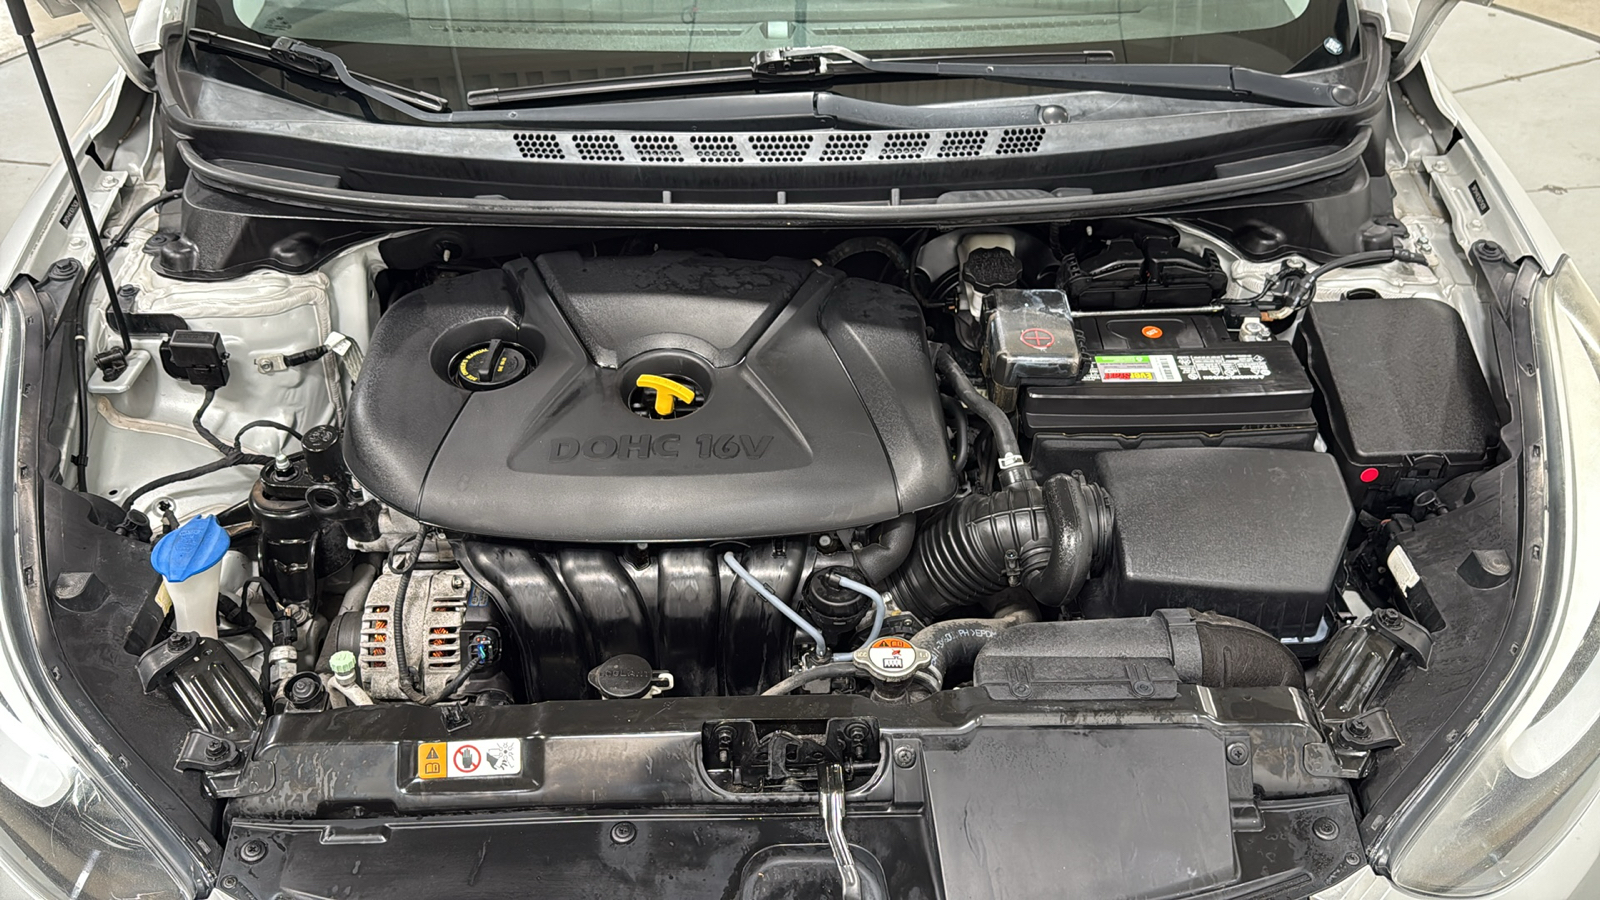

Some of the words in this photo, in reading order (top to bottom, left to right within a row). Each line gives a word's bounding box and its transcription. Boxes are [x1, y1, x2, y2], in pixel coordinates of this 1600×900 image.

[1103, 372, 1154, 380] EverStart
[548, 433, 681, 463] DOHC
[696, 433, 774, 461] 16V
